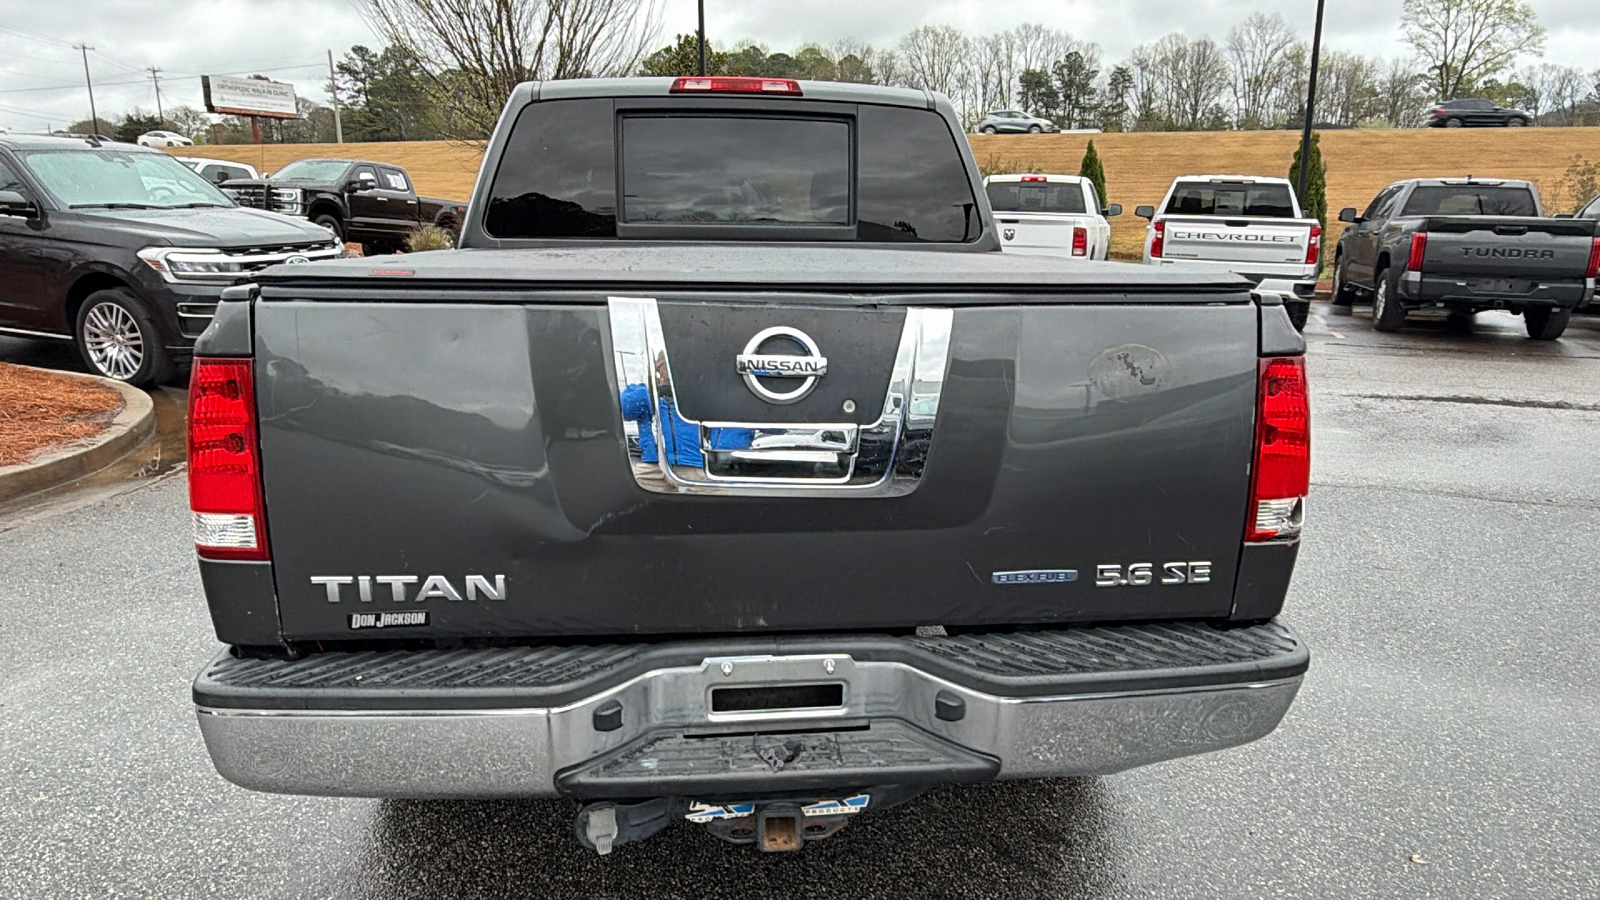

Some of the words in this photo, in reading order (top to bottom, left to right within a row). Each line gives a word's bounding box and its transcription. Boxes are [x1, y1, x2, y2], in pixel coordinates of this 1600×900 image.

[217, 84, 251, 93] ORTHOPEDIC
[1174, 231, 1299, 243] CHEVROLET
[1460, 247, 1555, 260] TUNDRA
[747, 359, 818, 372] NISSAN
[997, 572, 1035, 583] FLEX
[1037, 571, 1073, 582] FUEL
[1095, 562, 1153, 588] 5.6
[1161, 561, 1212, 586] SE
[310, 575, 506, 602] TITAN
[351, 613, 376, 629] DON
[376, 611, 426, 628] JACKSON
